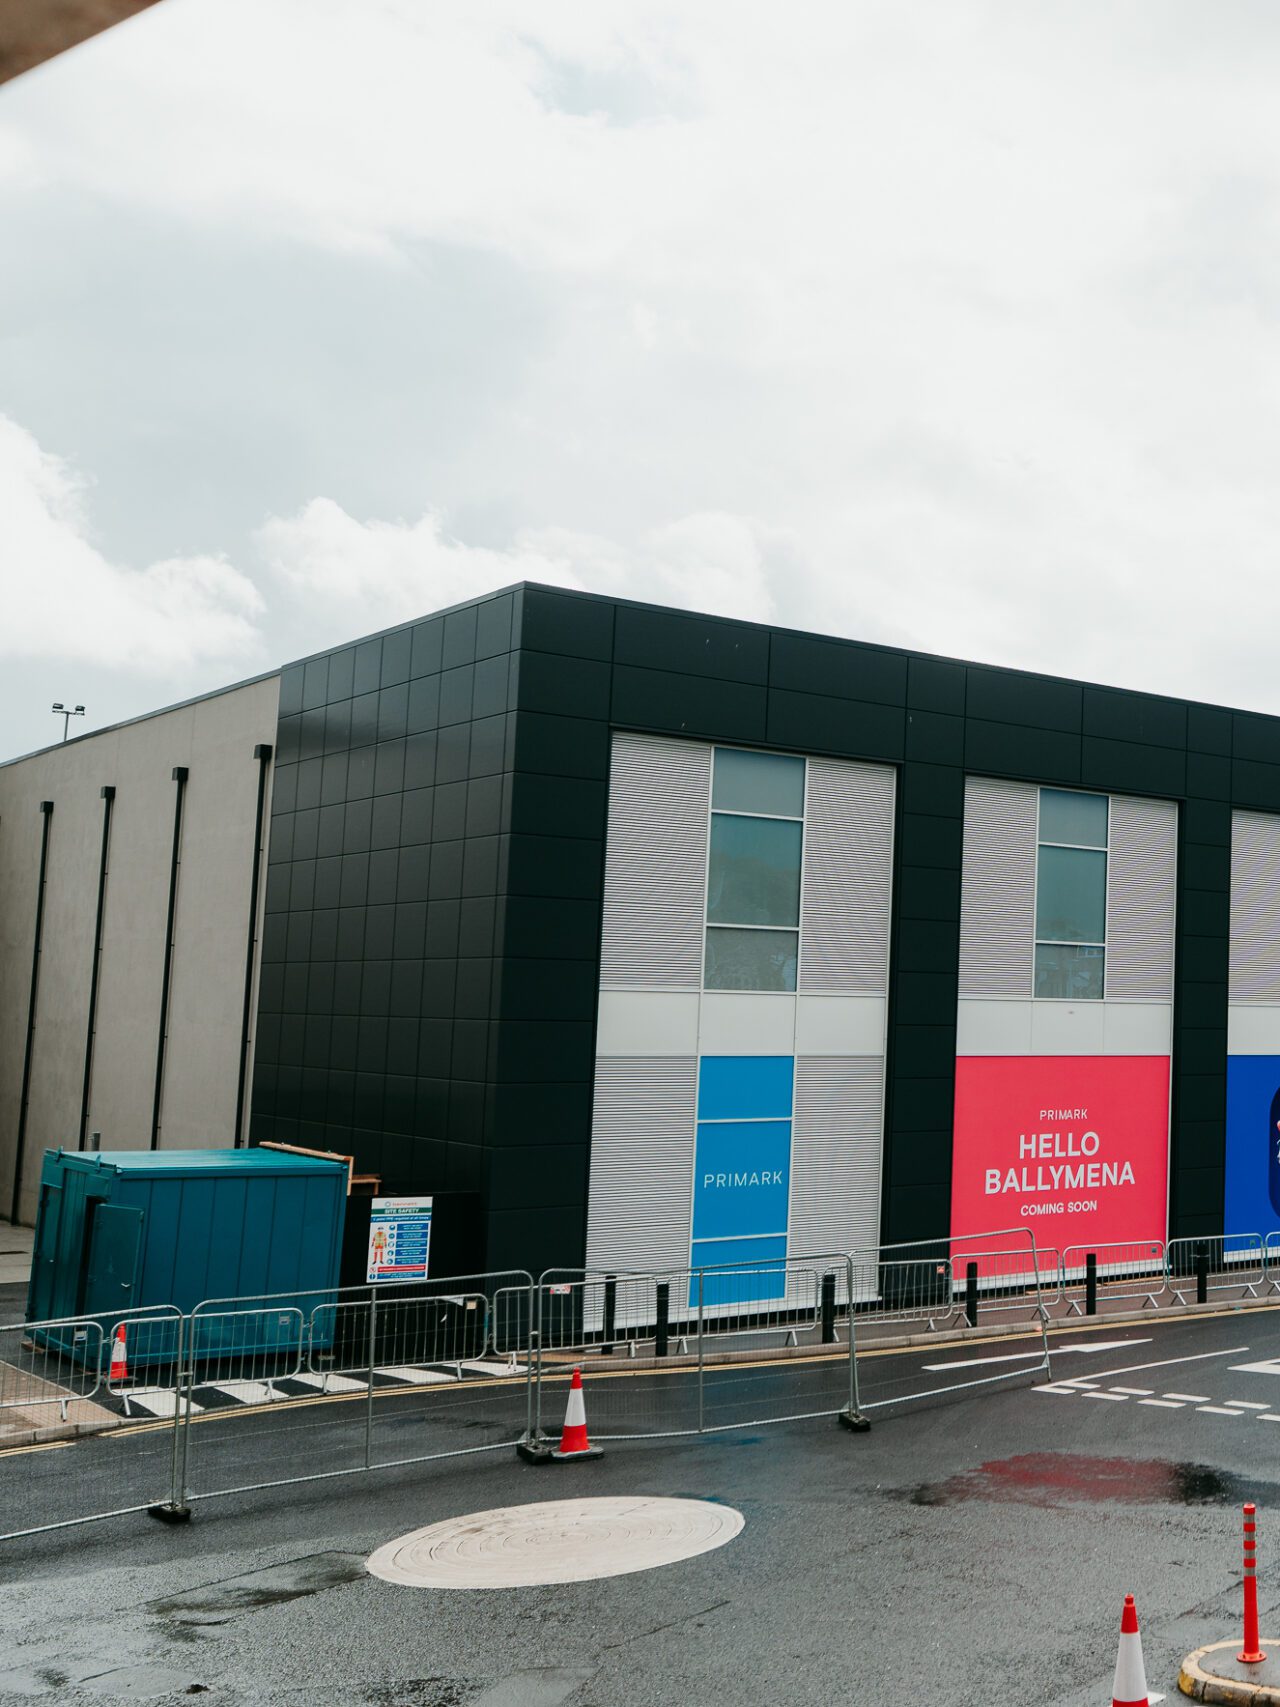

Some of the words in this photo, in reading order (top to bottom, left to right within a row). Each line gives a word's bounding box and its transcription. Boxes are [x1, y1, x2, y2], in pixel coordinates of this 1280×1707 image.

[1039, 1108, 1088, 1121] PRIMARK
[1019, 1131, 1100, 1160] HELLO
[703, 1170, 783, 1189] PRIMARK
[984, 1161, 1136, 1195] BALLYMENA
[1020, 1202, 1065, 1217] COMING
[1067, 1200, 1098, 1213] SOON
